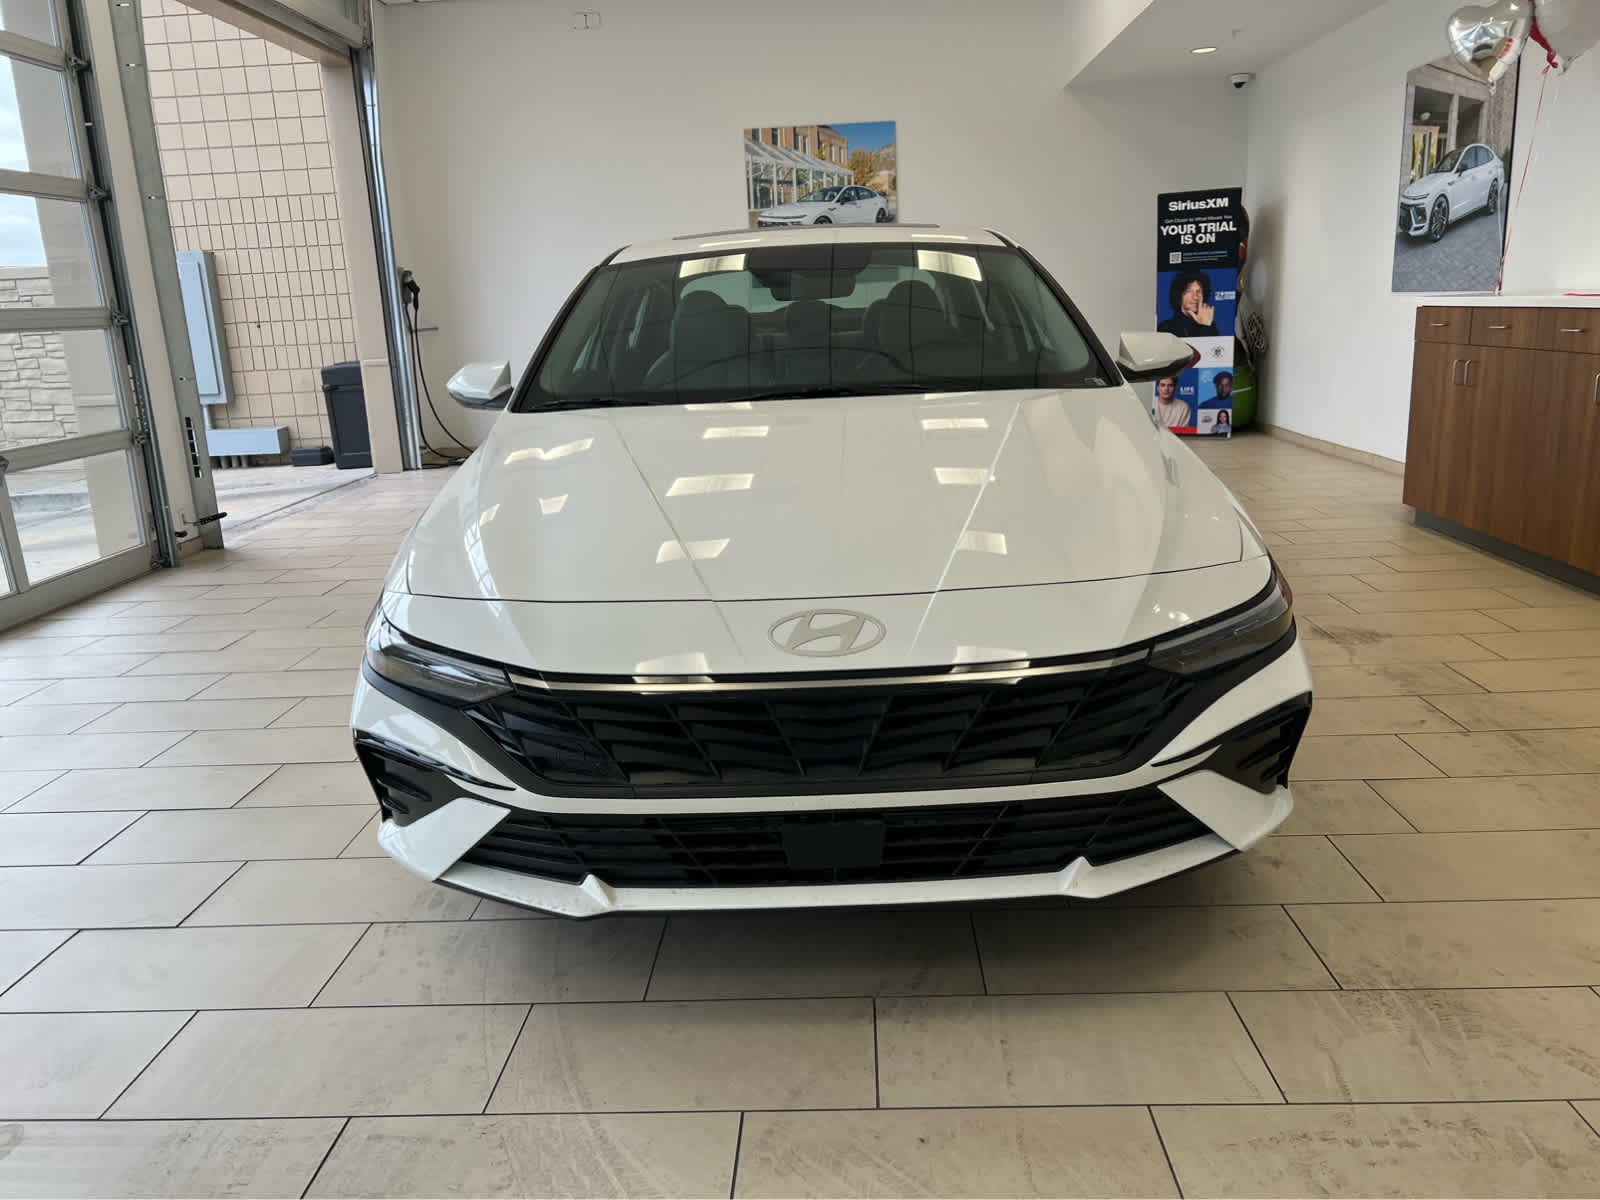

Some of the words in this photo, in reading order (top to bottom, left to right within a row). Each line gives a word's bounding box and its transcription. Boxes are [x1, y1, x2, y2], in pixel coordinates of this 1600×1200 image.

[1168, 197, 1229, 211] SiriusXM
[1160, 224, 1196, 236] YOUR
[1198, 221, 1237, 233] TRIAL
[1180, 234, 1193, 245] IS
[1195, 233, 1216, 244] ON
